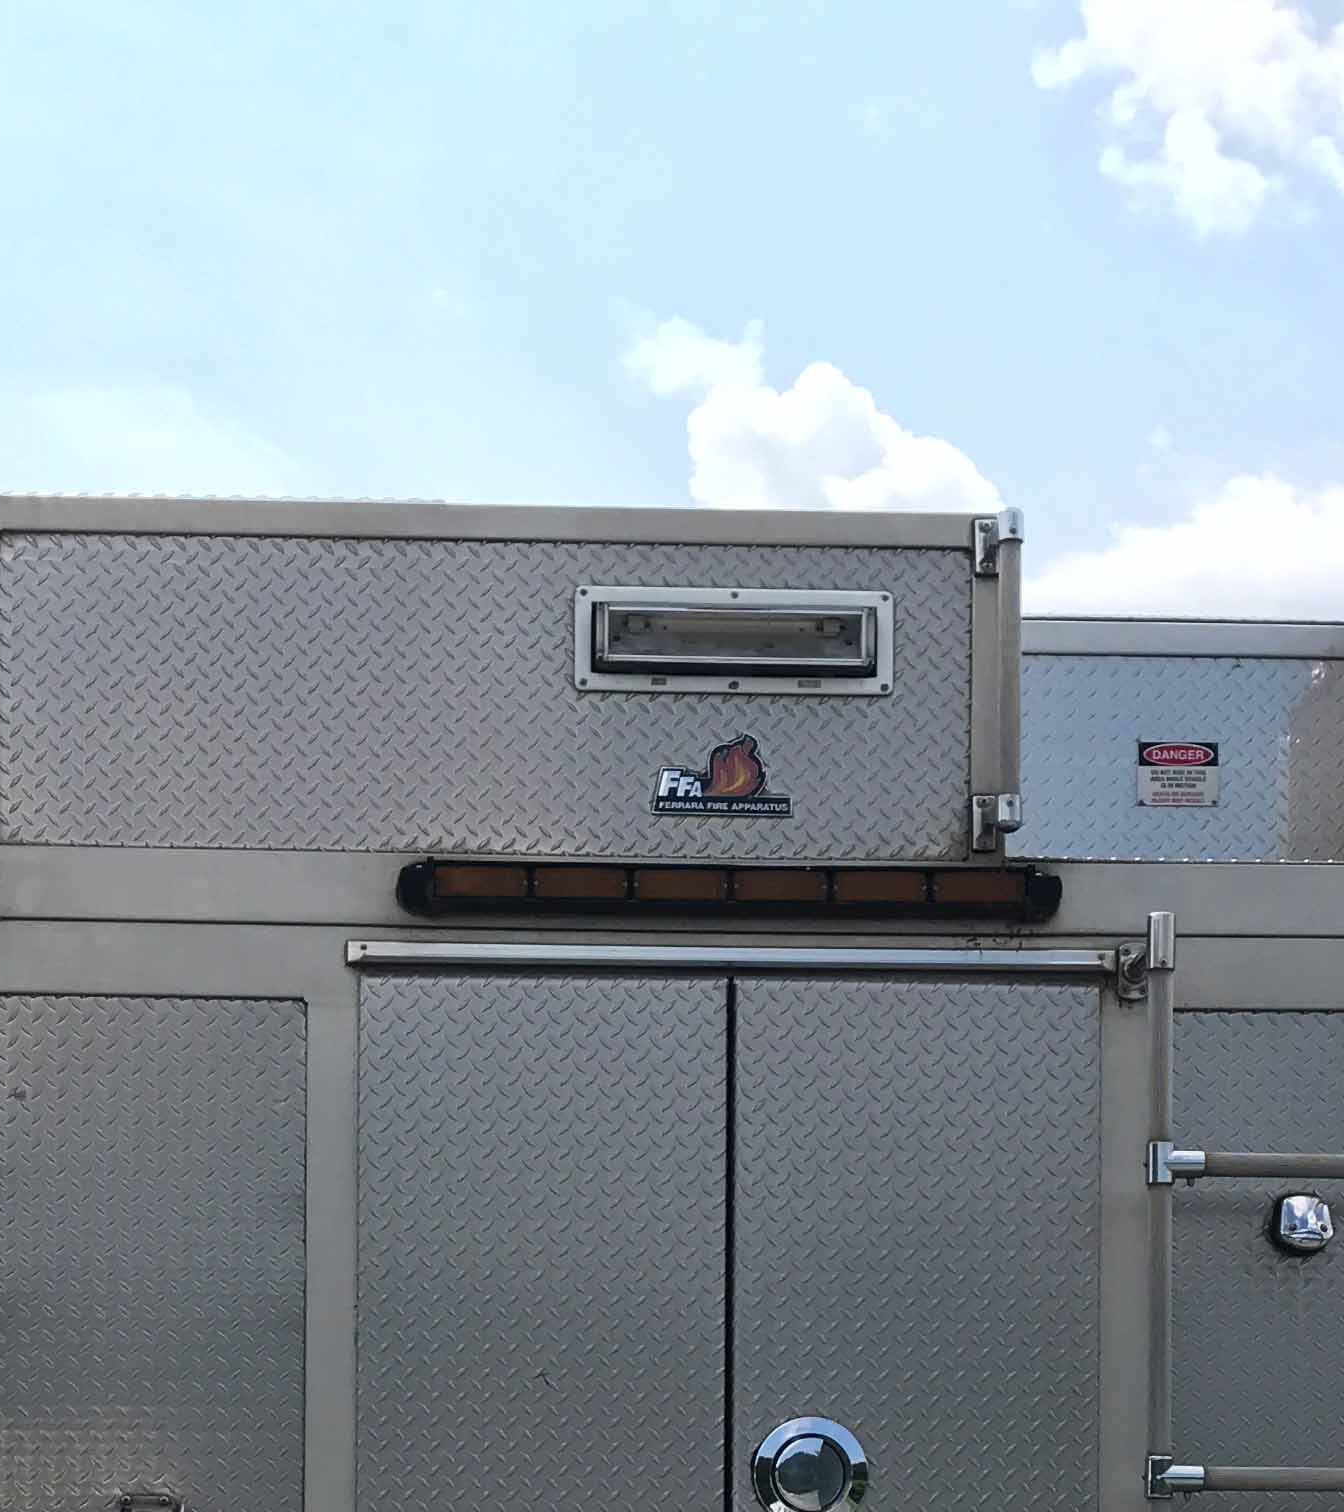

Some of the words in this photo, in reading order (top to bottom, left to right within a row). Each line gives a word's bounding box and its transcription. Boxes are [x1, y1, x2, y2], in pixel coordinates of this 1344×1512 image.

[1152, 750, 1205, 760] DANGER
[658, 770, 703, 798] FFA
[659, 801, 705, 810] FERRARA
[707, 801, 728, 810] FIRE
[731, 802, 789, 812] APPARATUS
